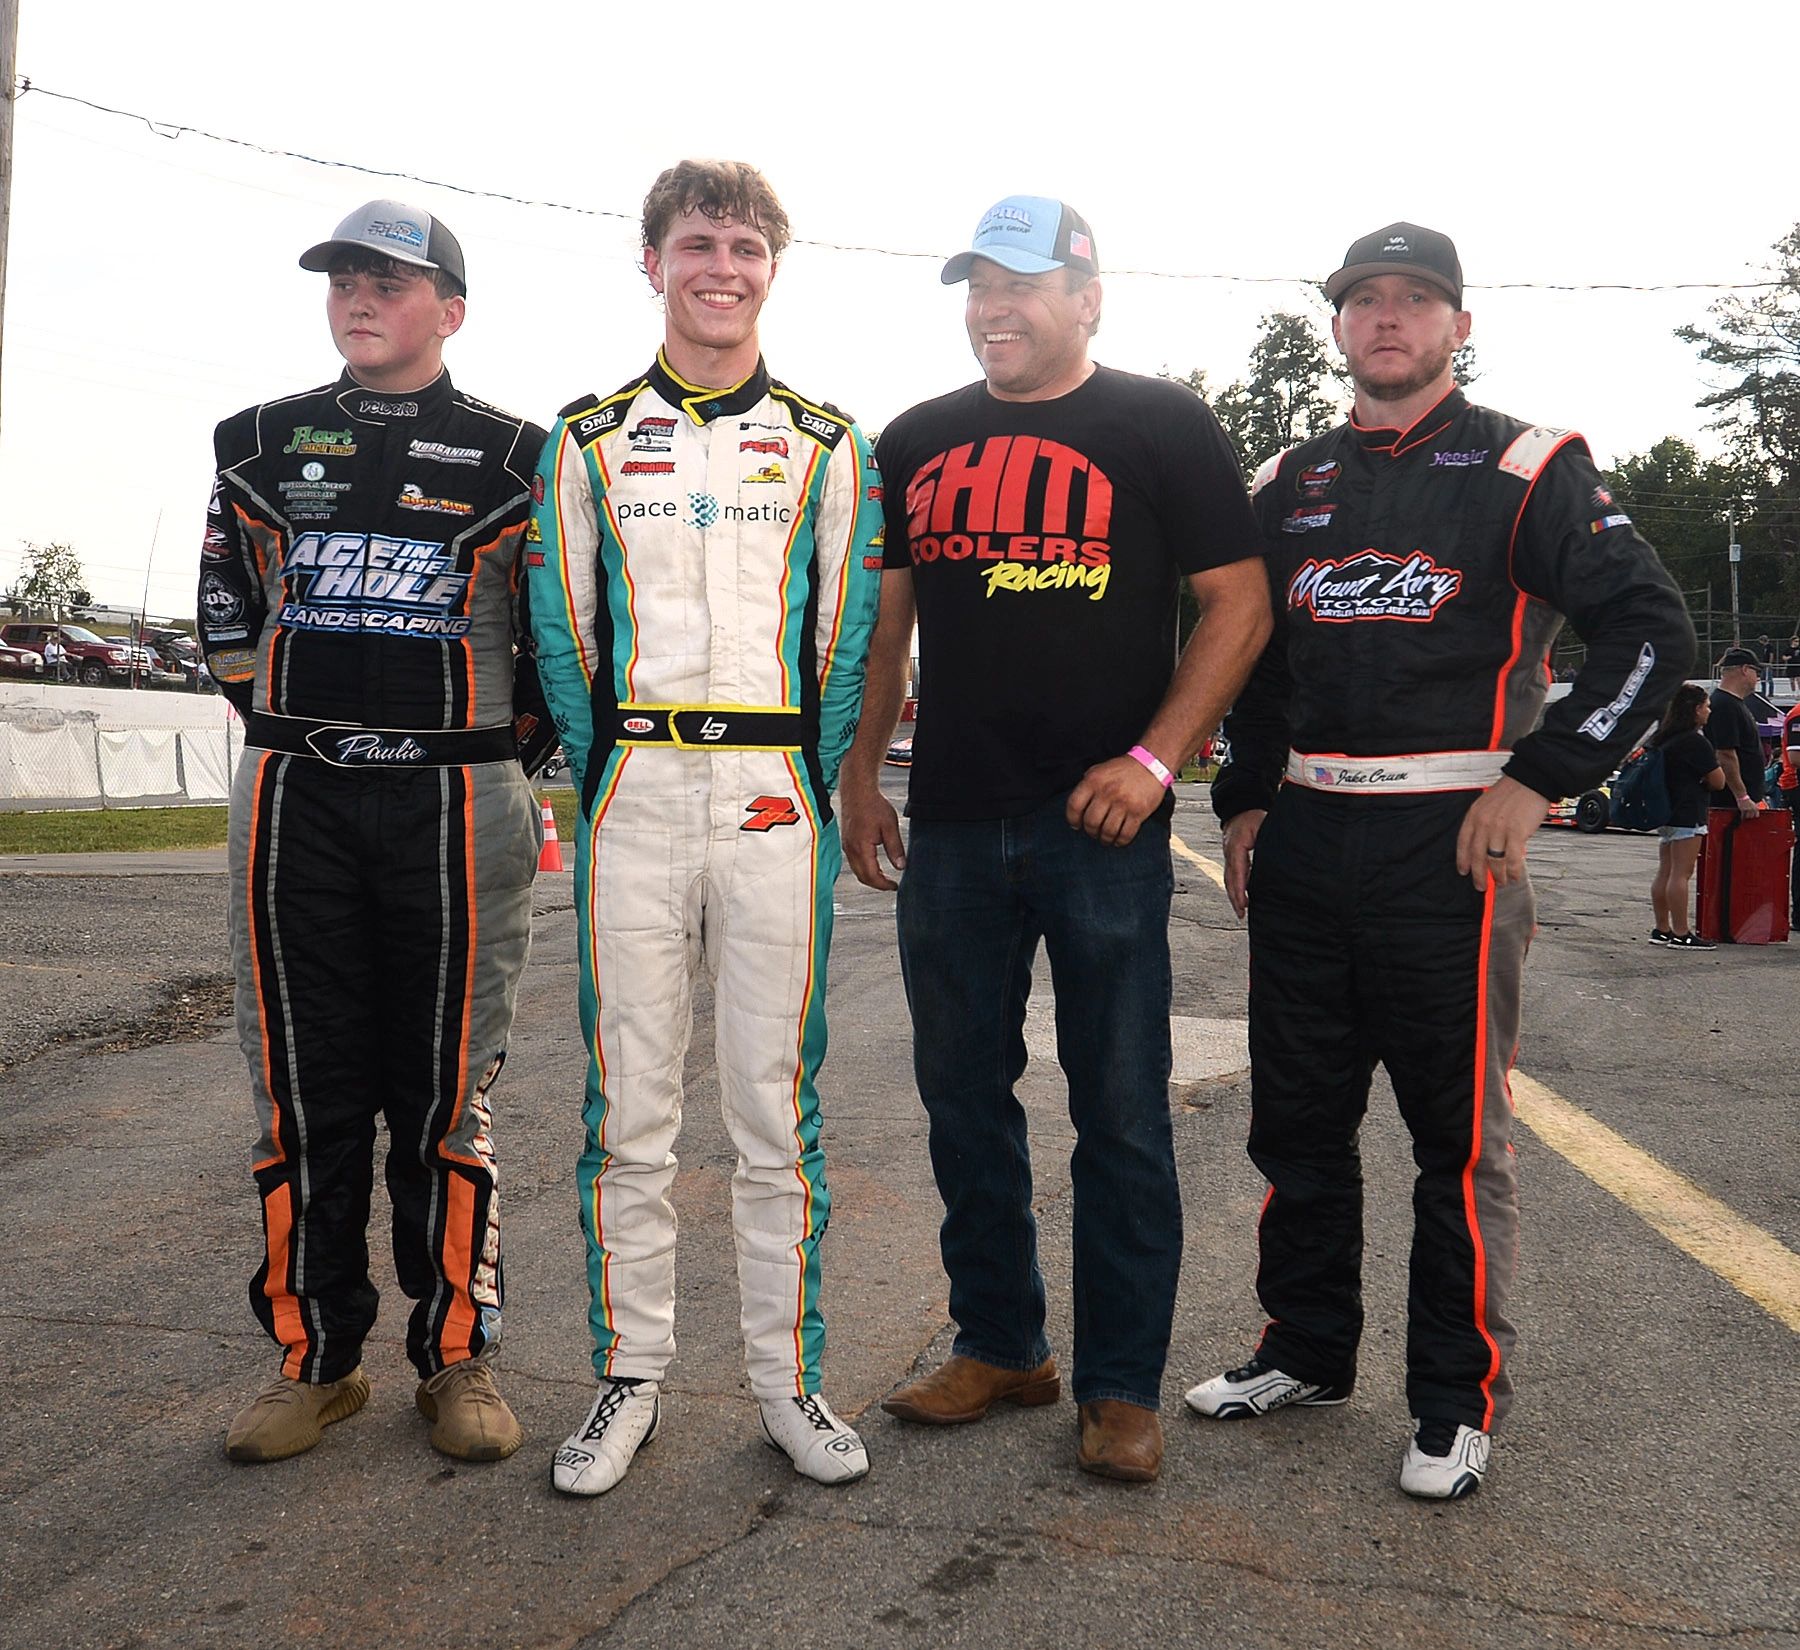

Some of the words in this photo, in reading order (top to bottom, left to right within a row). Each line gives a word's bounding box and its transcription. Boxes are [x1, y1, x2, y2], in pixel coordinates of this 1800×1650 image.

[580, 410, 615, 432] OMP
[801, 413, 836, 434] OMP
[620, 461, 675, 473] MOHAWK
[617, 501, 677, 527] pace
[724, 501, 790, 523] matic
[284, 535, 400, 570] ACE
[401, 543, 434, 560] IN
[911, 535, 1111, 567] COOLERS
[393, 557, 447, 574] THE
[312, 567, 466, 605] HOLE
[981, 560, 1112, 600] Racing
[1288, 564, 1382, 608] Mount
[1380, 556, 1459, 606] Airy
[1318, 597, 1427, 609] TOYOTA
[281, 607, 470, 634] LANDSCAPING
[627, 721, 652, 729] BELL
[336, 734, 424, 761] Paulie
[1336, 769, 1367, 785] Jake
